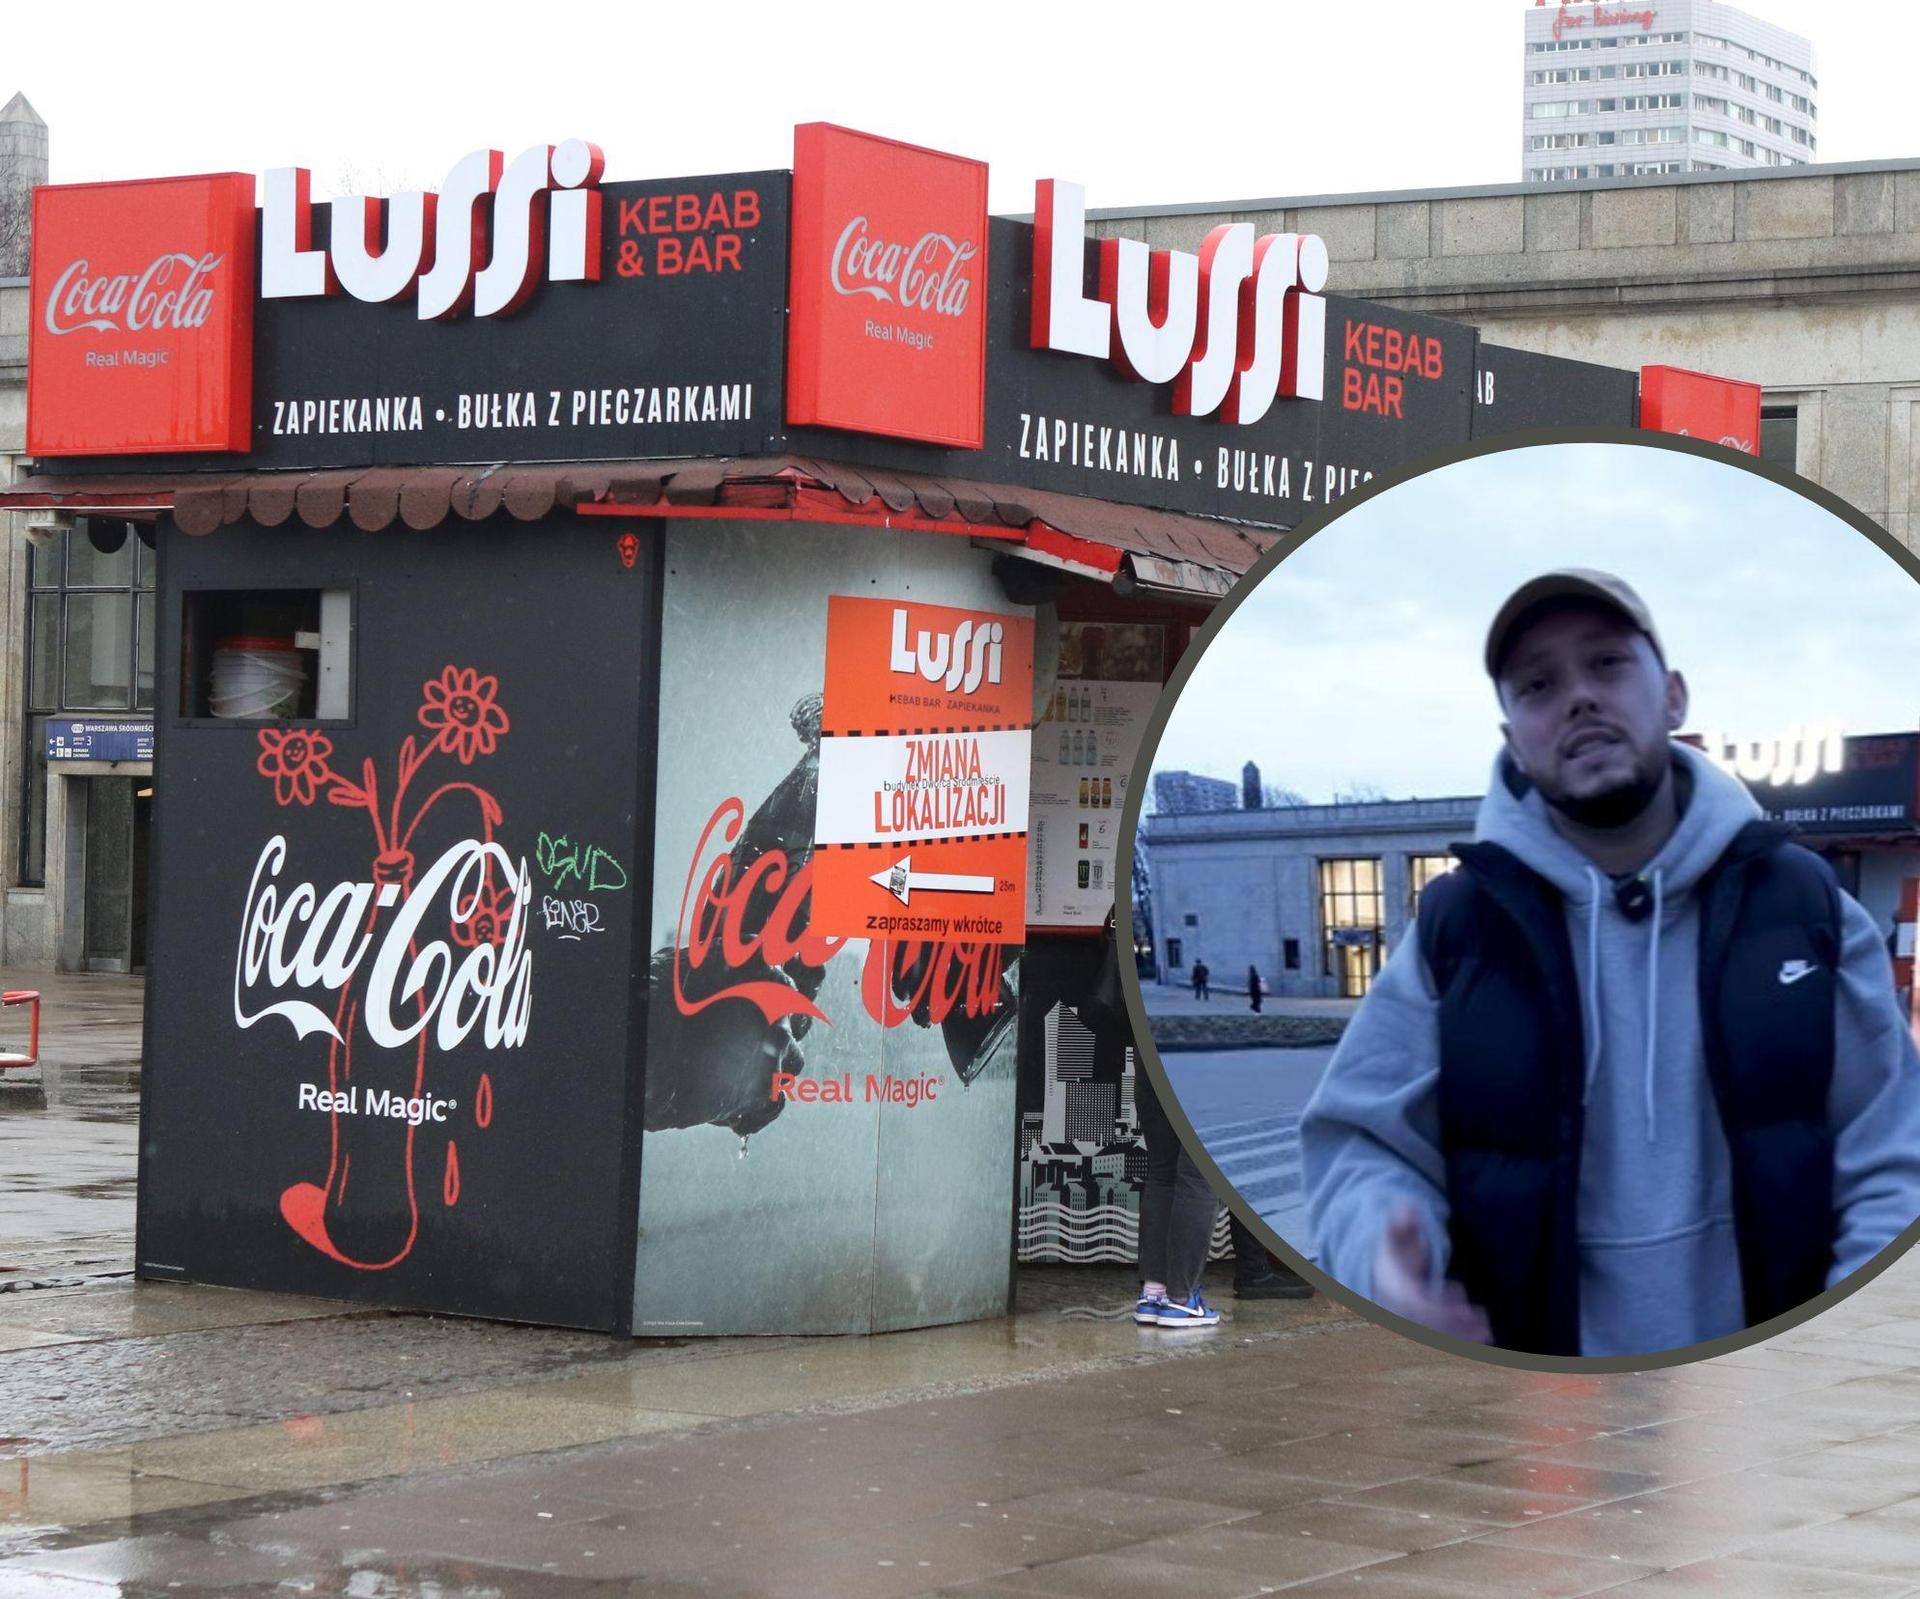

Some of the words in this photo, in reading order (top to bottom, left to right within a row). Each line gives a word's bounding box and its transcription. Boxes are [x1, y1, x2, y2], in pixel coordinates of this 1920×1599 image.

[618, 190, 761, 236] KEBAB
[617, 240, 645, 278] &
[656, 233, 742, 276] BAR
[831, 215, 977, 317] Coca-Cola
[45, 252, 223, 335] Coca-Cola
[864, 319, 893, 341] Real
[896, 326, 934, 350] Magic
[1344, 318, 1444, 380] KEBAB
[86, 351, 119, 367] Real
[123, 351, 170, 368] Magic
[273, 396, 423, 436] ZAPIEKANKA
[457, 392, 537, 429] BUŁKA
[548, 390, 561, 427] Z
[572, 383, 753, 426] PIECZARKAMI
[1342, 366, 1404, 420] BAR
[1019, 413, 1180, 482] ZAPIEKANKA
[1217, 446, 1290, 499] BUŁKA
[1303, 461, 1314, 502] Z
[890, 693, 921, 707] KEBAB
[923, 697, 941, 709] BAR
[947, 699, 1000, 715] ZAPIEKANKA
[85, 724, 118, 732] WARSZAWA
[86, 735, 92, 746] 3
[905, 738, 983, 782] ZMIANA
[874, 783, 1006, 833] LOKALIZACJI
[999, 880, 1016, 893] 25m
[234, 835, 532, 1051] Coca-Cola
[866, 914, 950, 936] zapraszamy
[953, 914, 1003, 935] wkrótce
[298, 1082, 358, 1115] Real
[771, 1072, 852, 1104] Real
